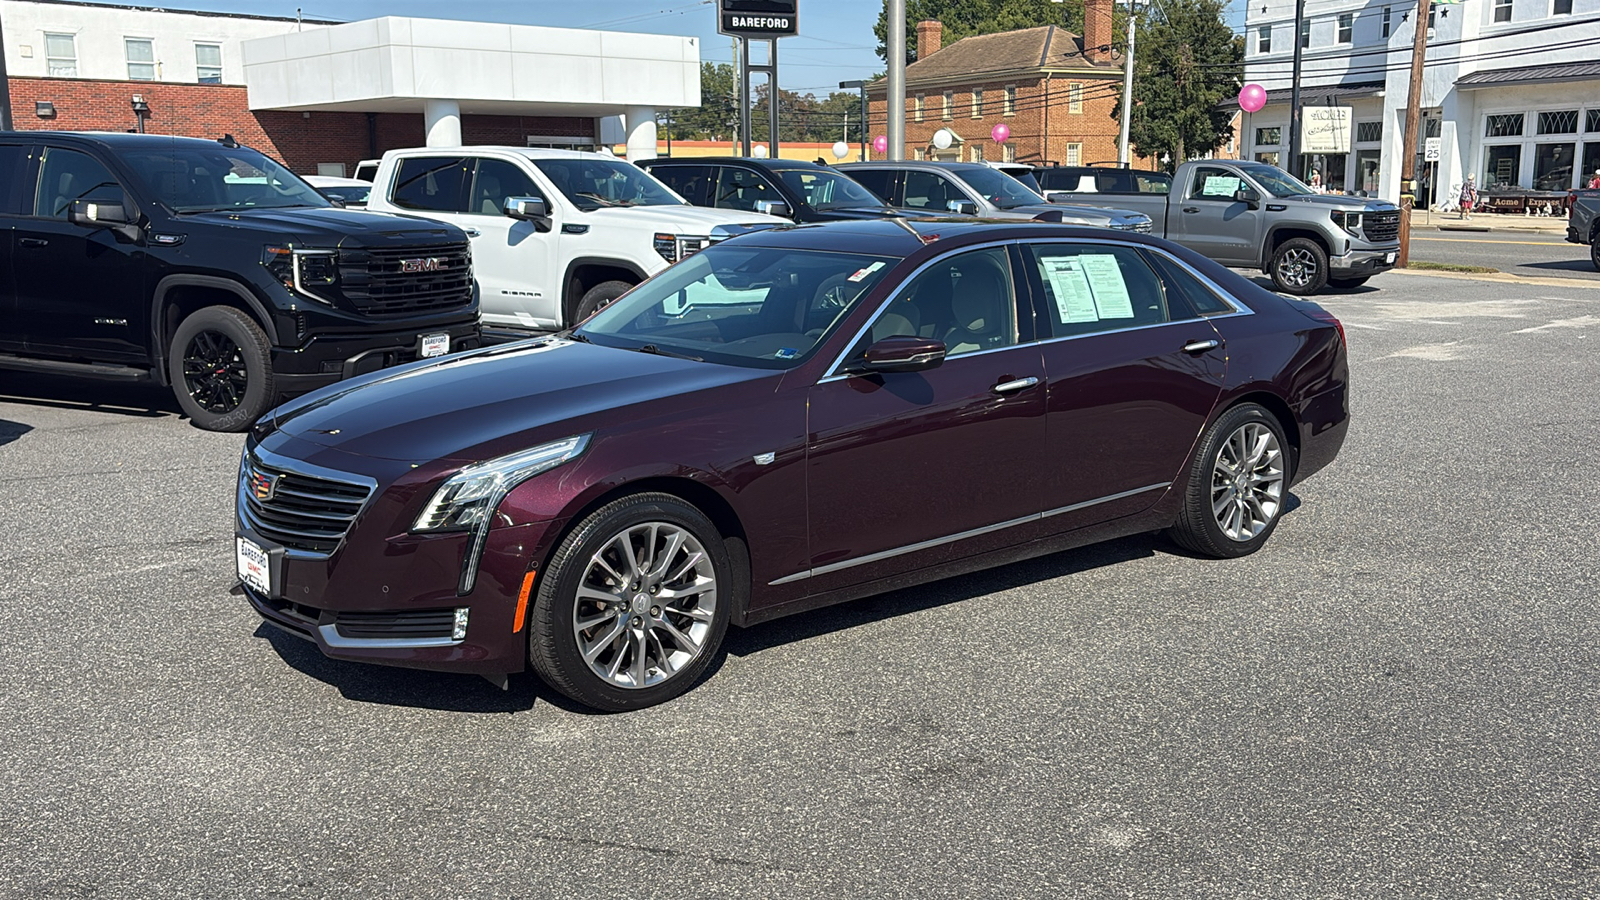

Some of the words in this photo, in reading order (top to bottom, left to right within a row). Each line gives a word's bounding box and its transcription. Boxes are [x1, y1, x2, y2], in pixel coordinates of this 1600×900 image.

[732, 17, 788, 28] BAREFORD
[1427, 149, 1439, 158] 25
[1494, 198, 1519, 206] Acme
[403, 257, 449, 273] GMC
[424, 336, 447, 346] BAREFORD
[241, 543, 267, 569] BAREFORD
[247, 562, 262, 576] GMC
